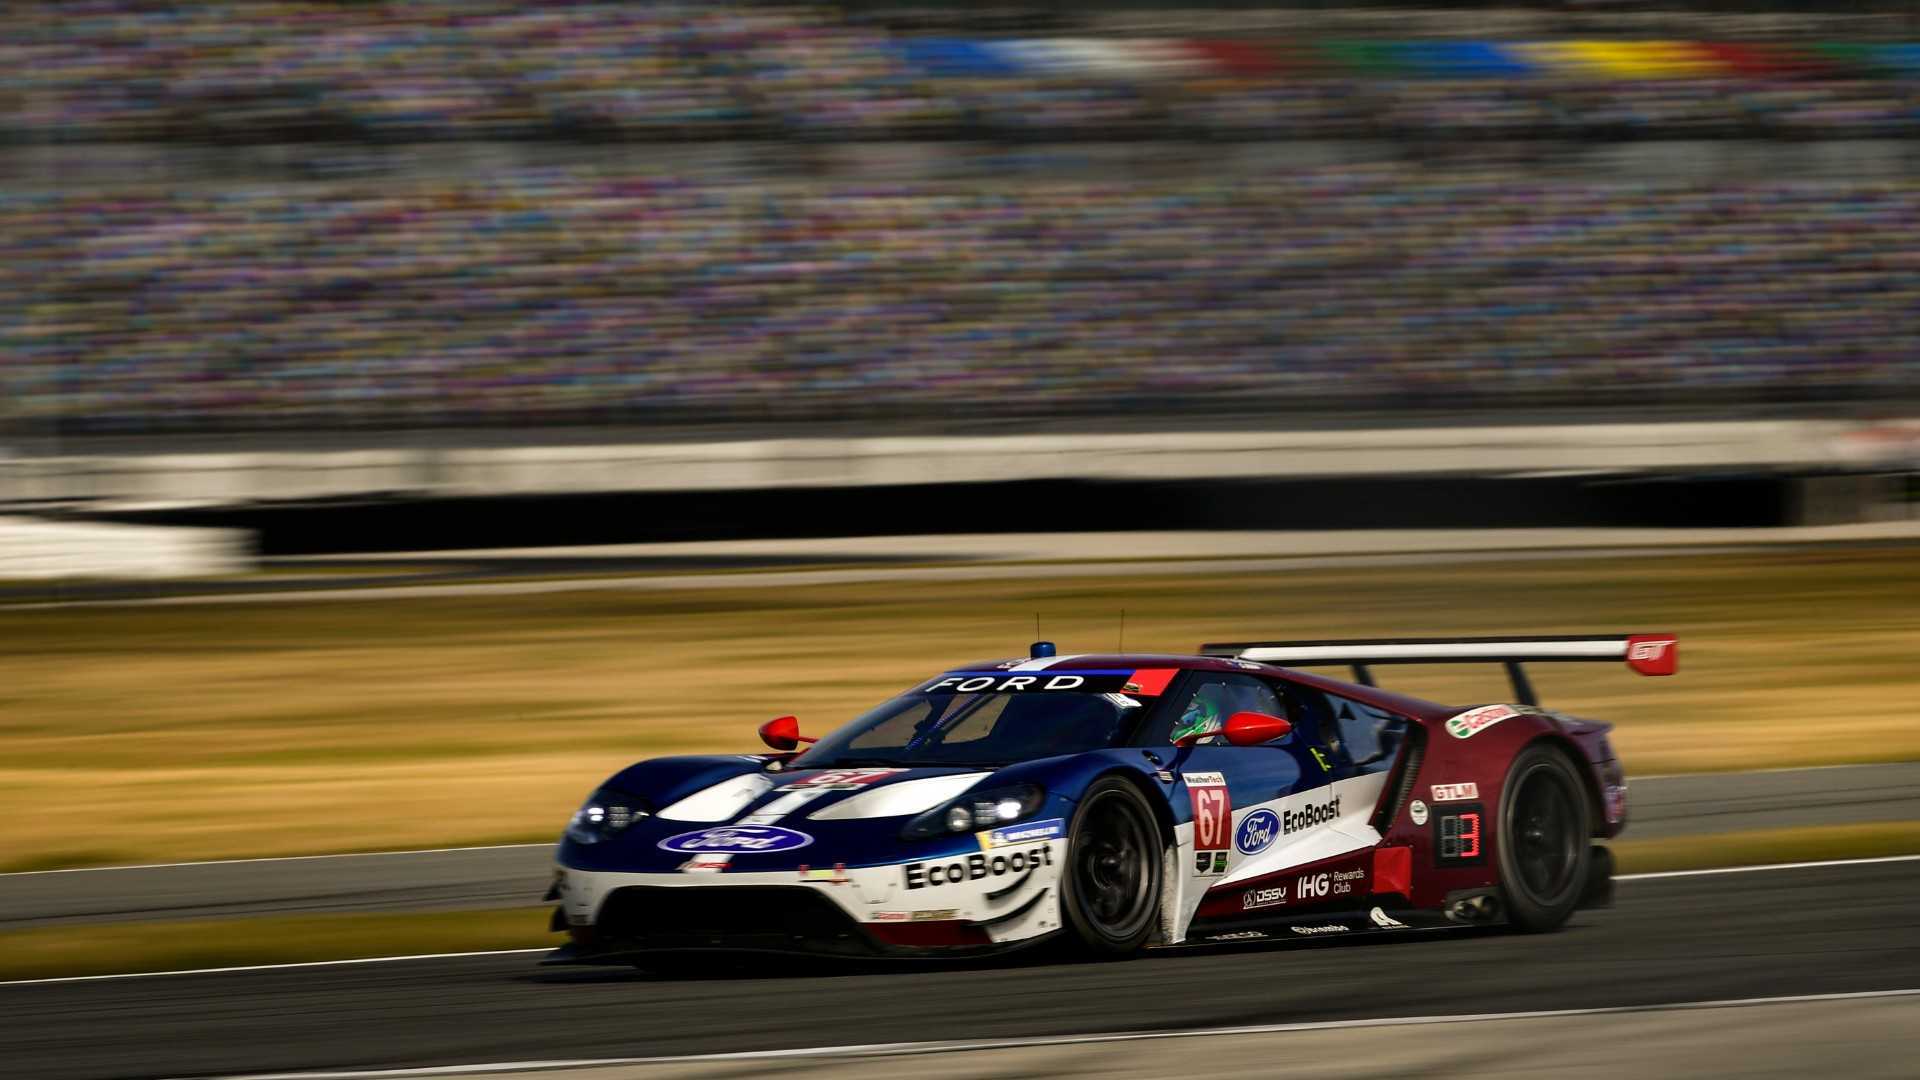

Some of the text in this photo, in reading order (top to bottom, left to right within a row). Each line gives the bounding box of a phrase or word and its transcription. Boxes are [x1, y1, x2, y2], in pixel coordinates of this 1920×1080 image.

[925, 675, 1085, 692] FORD
[808, 771, 890, 784] 67
[1184, 775, 1223, 784] WeatherTech
[1434, 784, 1476, 800] GTLM
[1197, 788, 1225, 847] 67
[1283, 797, 1341, 836] EcoBoost
[679, 827, 788, 849] Ford
[1243, 815, 1272, 849] Ford
[905, 844, 1052, 890] EcoBoost
[1297, 868, 1365, 899] IHG Rewards
[1333, 881, 1351, 894] Club
[1256, 886, 1287, 902] DSSV
